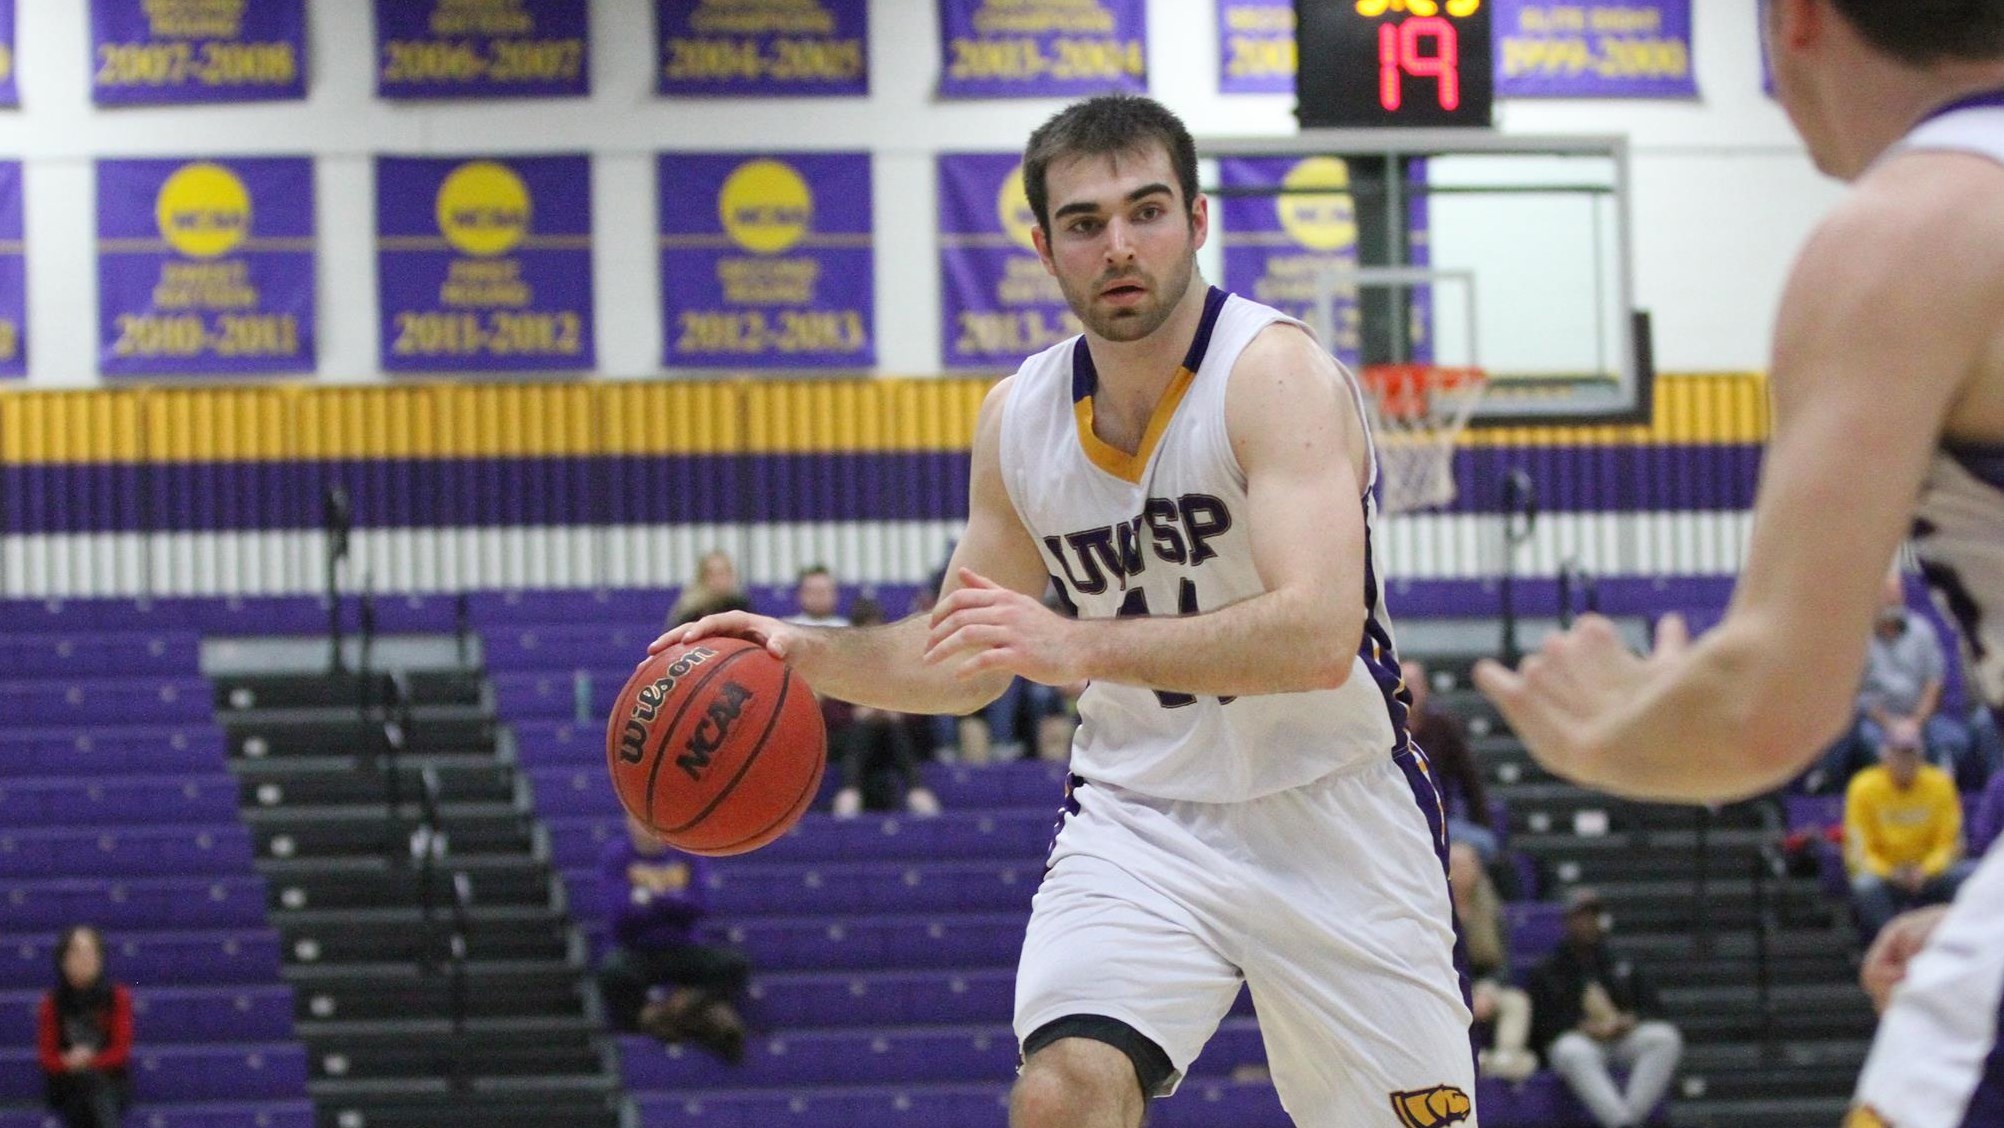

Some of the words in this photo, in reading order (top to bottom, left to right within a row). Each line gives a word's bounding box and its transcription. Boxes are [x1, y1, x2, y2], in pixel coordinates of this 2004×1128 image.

[98, 42, 293, 84] 2007-2008
[1378, 16, 1459, 111] 19
[1503, 37, 1687, 78] 1999-2000
[115, 313, 297, 356] 2010-2011
[394, 311, 579, 355] 2011-2012
[679, 310, 865, 353] 2012-2013
[1044, 493, 1232, 595] UWSP
[620, 647, 719, 764] Wilson
[676, 681, 753, 782] NCAA
